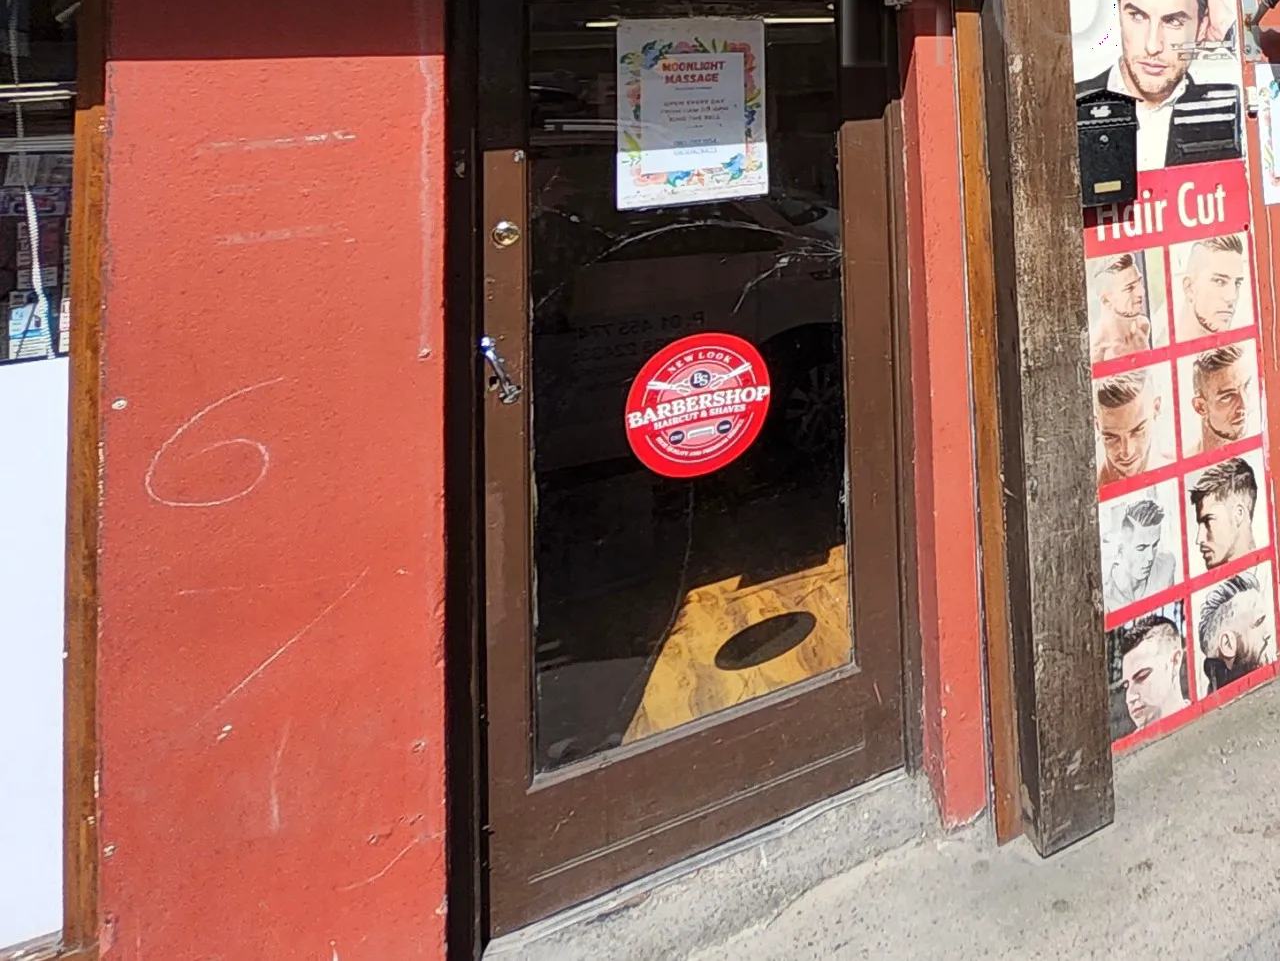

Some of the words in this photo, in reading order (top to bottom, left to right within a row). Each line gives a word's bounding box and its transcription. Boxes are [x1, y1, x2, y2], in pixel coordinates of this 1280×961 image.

[662, 61, 726, 72] MOONLIGHT
[665, 73, 719, 84] MASSAGE
[1096, 190, 1168, 241] Hair
[1177, 181, 1226, 228] Cut
[667, 353, 695, 373] NEW
[698, 351, 733, 364] LOOK
[627, 385, 770, 429] BARBERSHOP
[653, 412, 699, 430] HAIRCUT
[700, 409, 708, 418] &
[709, 404, 746, 417] SHAVES
